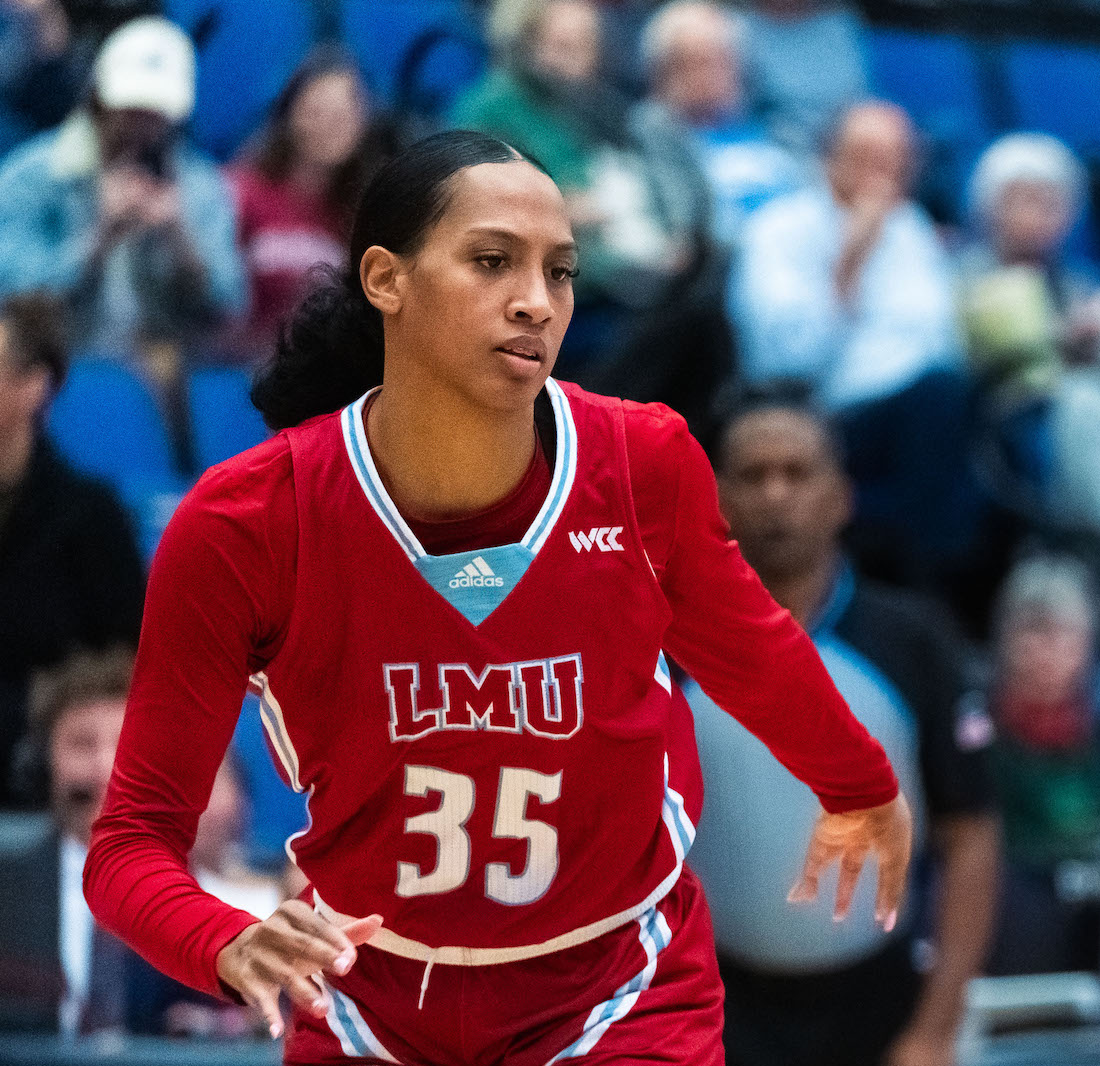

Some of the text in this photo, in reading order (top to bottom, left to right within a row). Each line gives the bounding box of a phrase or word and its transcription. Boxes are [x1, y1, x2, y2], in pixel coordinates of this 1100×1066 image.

[568, 526, 625, 553] WCC
[449, 575, 504, 588] adidas
[383, 652, 584, 743] LMU
[395, 763, 563, 907] 35
